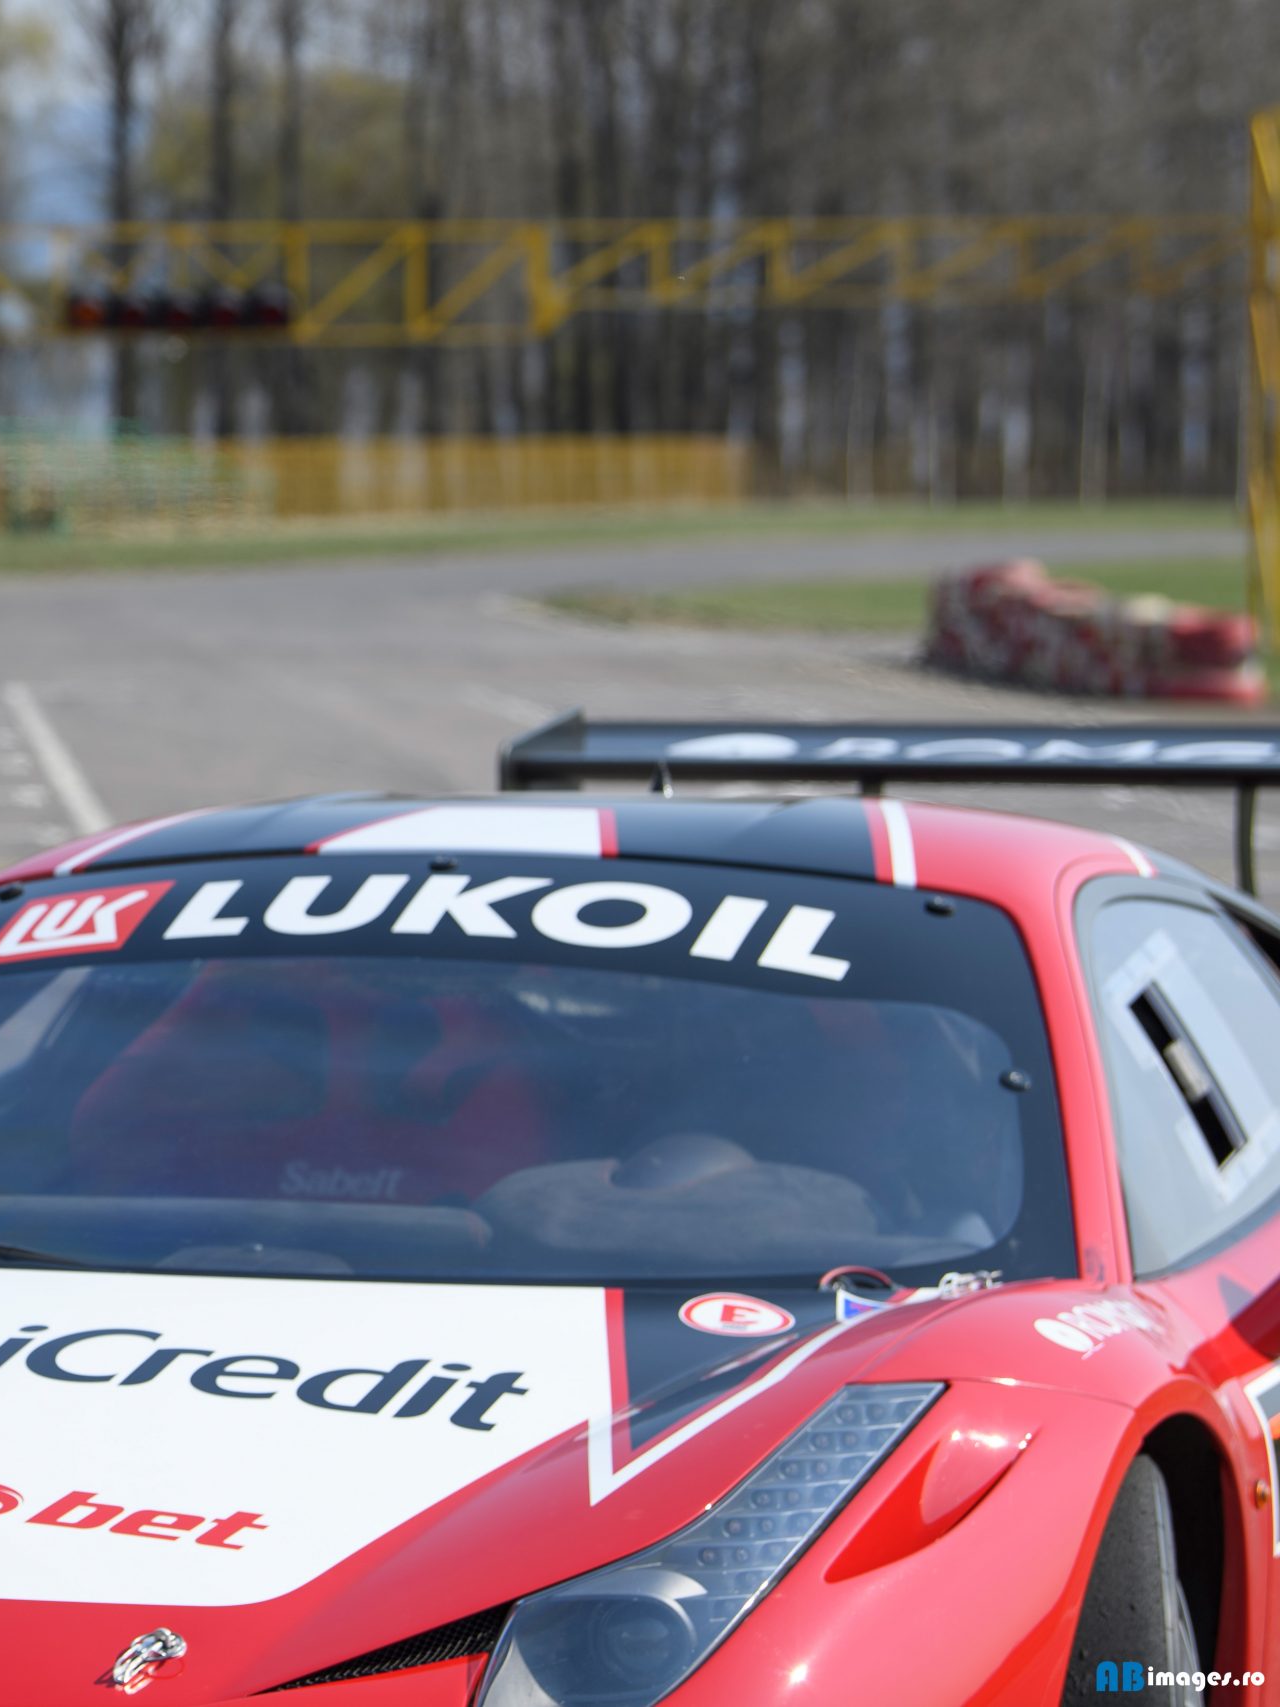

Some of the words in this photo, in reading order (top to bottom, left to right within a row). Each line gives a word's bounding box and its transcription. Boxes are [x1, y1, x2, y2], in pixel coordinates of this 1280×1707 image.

[162, 873, 851, 982] LUKOIL
[719, 1304, 760, 1325] E
[26, 1490, 270, 1551] bet
